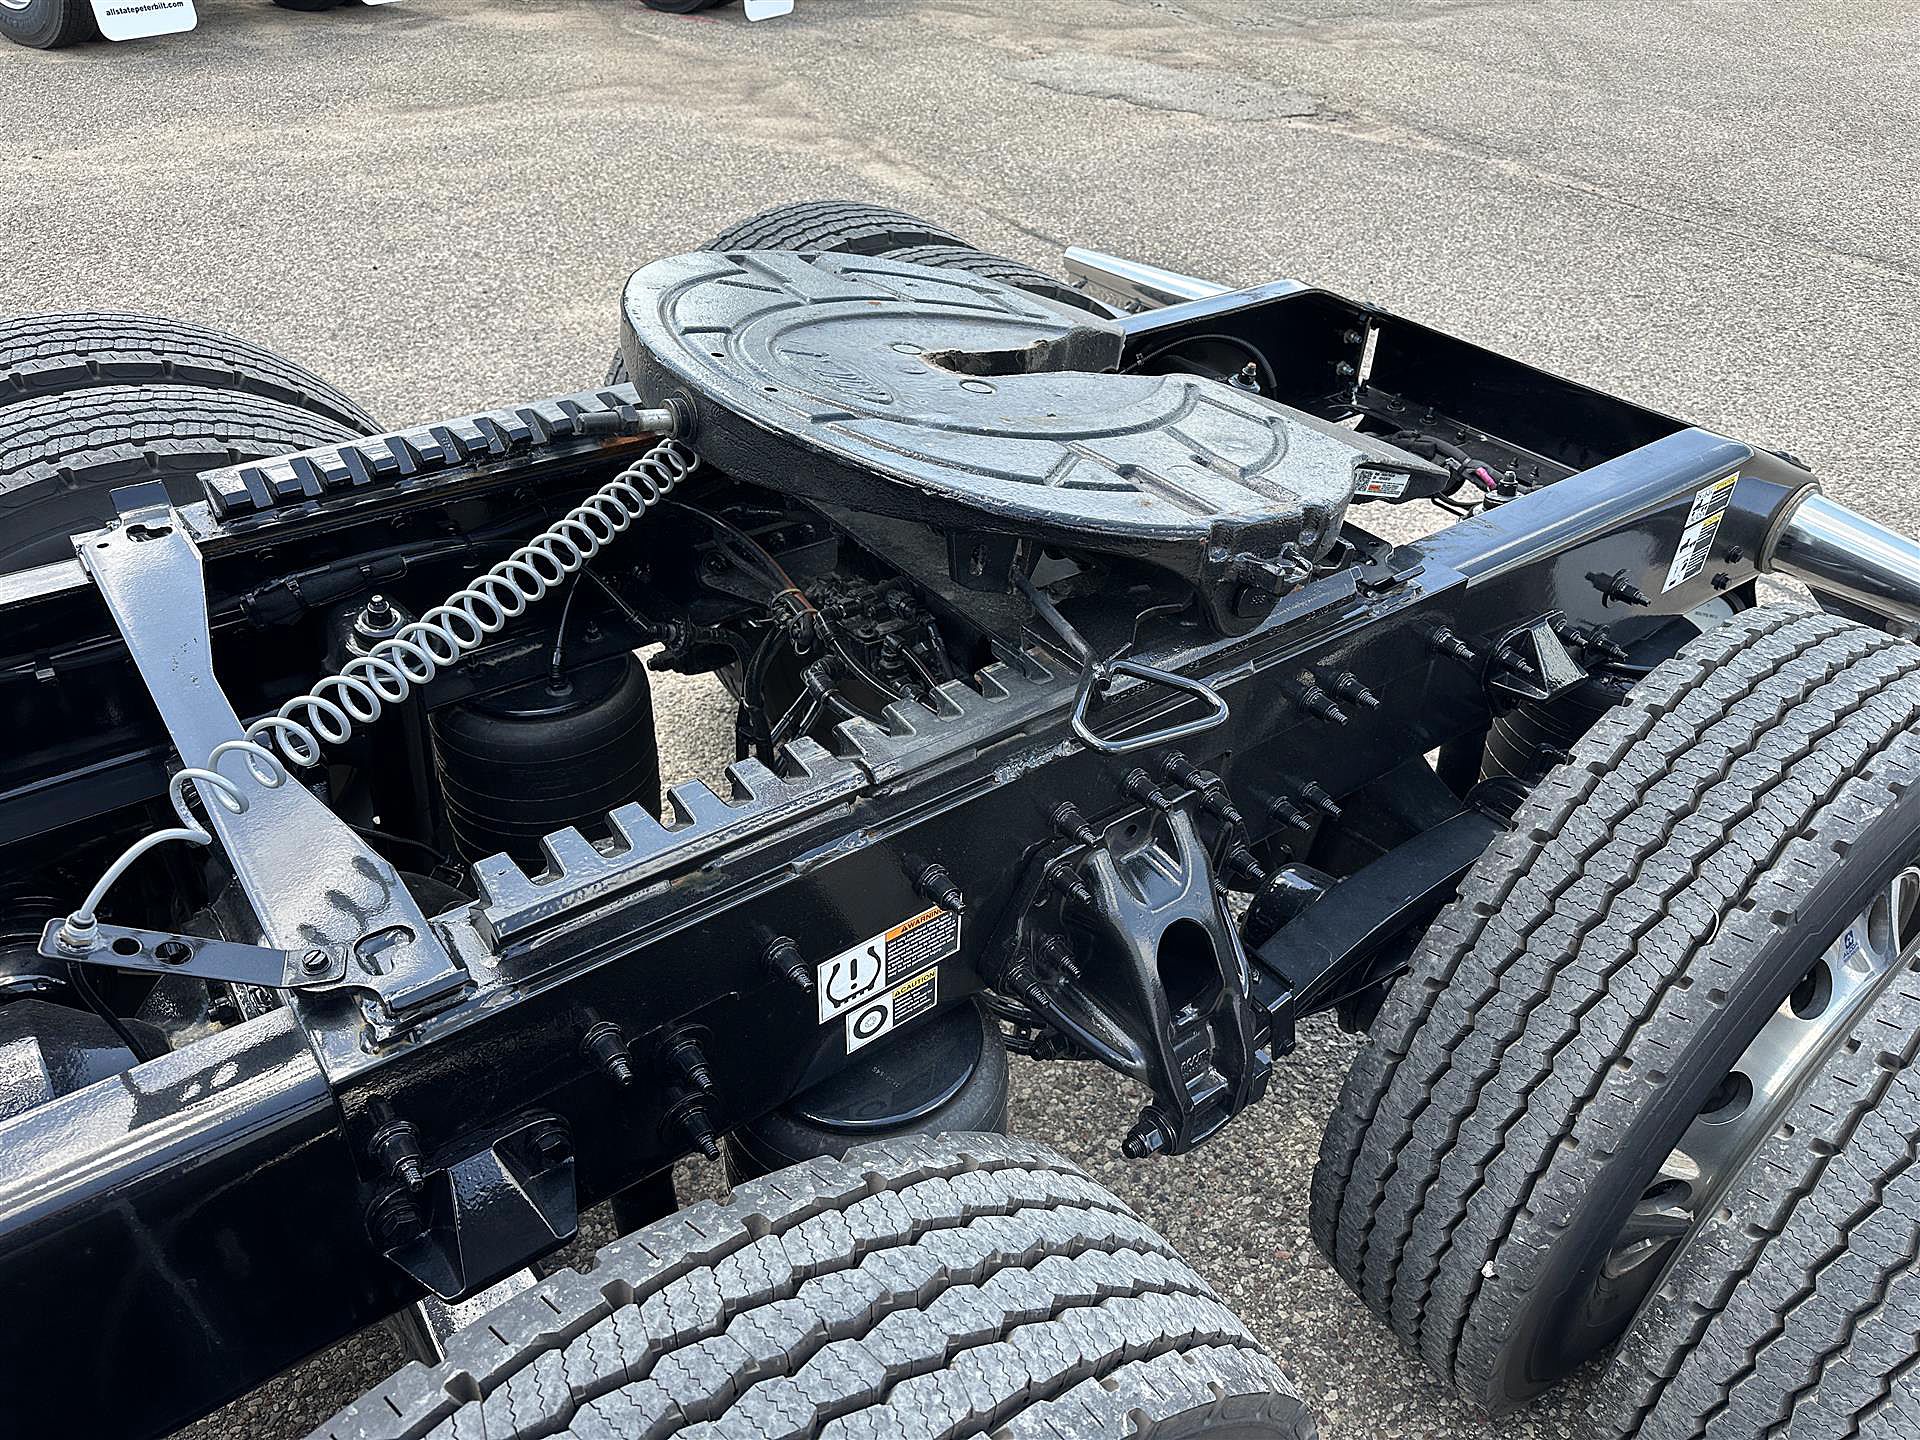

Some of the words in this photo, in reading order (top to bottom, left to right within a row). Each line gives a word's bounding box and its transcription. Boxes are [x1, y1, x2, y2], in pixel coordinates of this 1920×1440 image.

[105, 1, 184, 16] allstatepeterbilt.com
[906, 908, 943, 929] WARNIN
[900, 971, 935, 993] CAUTION
